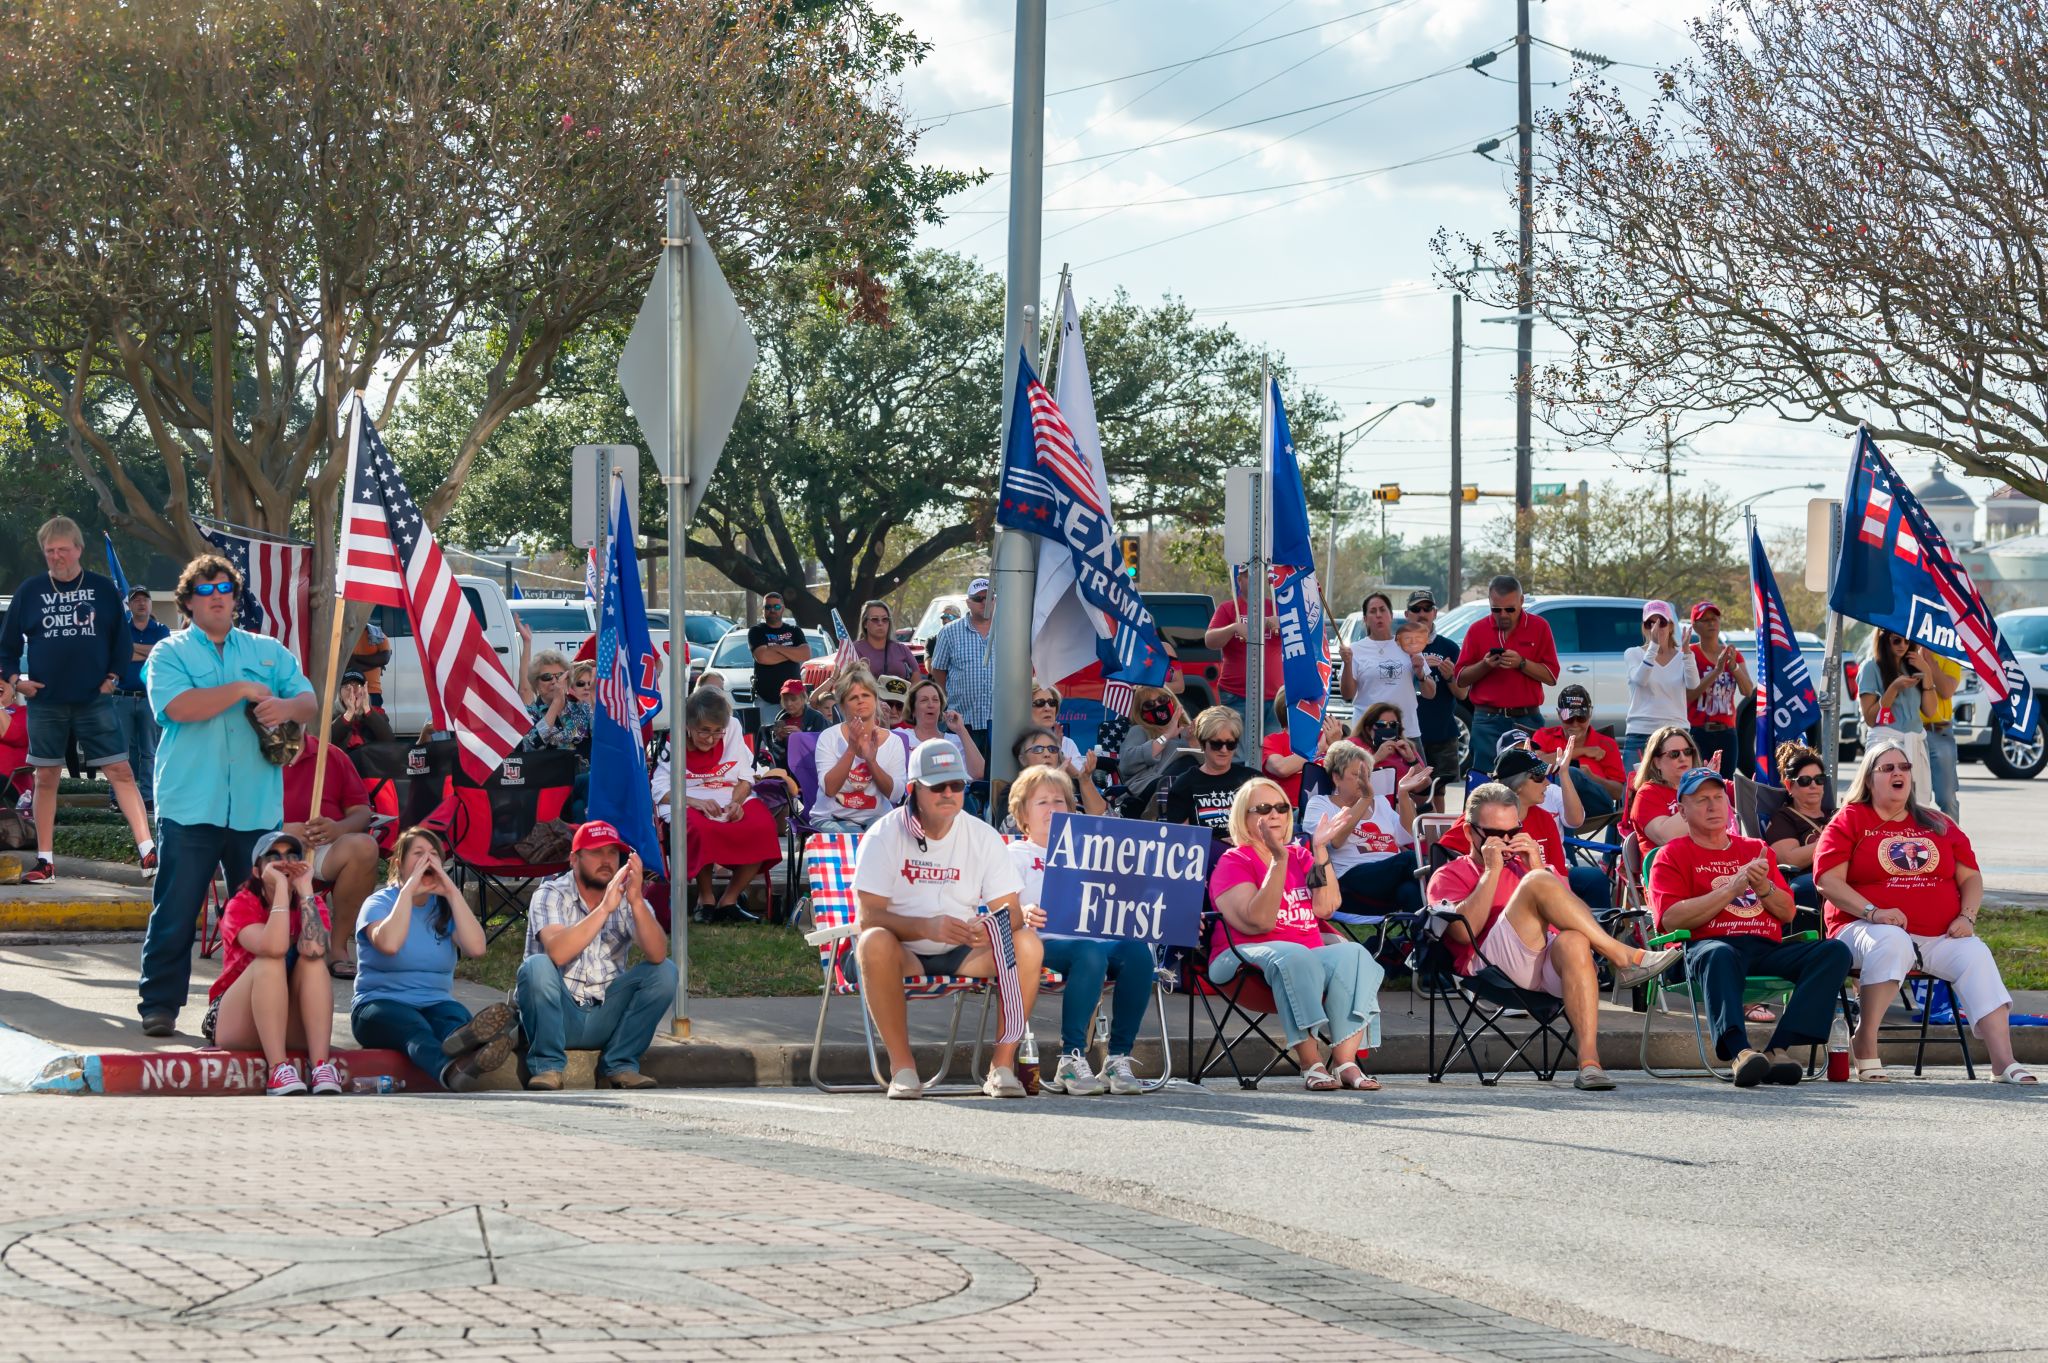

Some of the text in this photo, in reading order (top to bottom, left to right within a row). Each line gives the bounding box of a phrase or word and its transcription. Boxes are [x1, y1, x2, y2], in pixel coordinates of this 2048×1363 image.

[40, 589, 96, 605] WHERE
[524, 590, 576, 600] Kevin Laine
[1080, 561, 1152, 627] TRUMP
[42, 606, 57, 614] WE
[42, 614, 73, 629] ONE
[44, 627, 96, 638] WE GO ALL
[1280, 607, 1306, 660] THE
[1057, 710, 1087, 720] ulian
[716, 763, 731, 776] GIRL
[1046, 816, 1205, 882] America
[907, 867, 958, 880] TRUMP
[1074, 881, 1167, 940] First
[1708, 917, 1765, 930] Inauguration
[142, 1058, 192, 1089] NO
